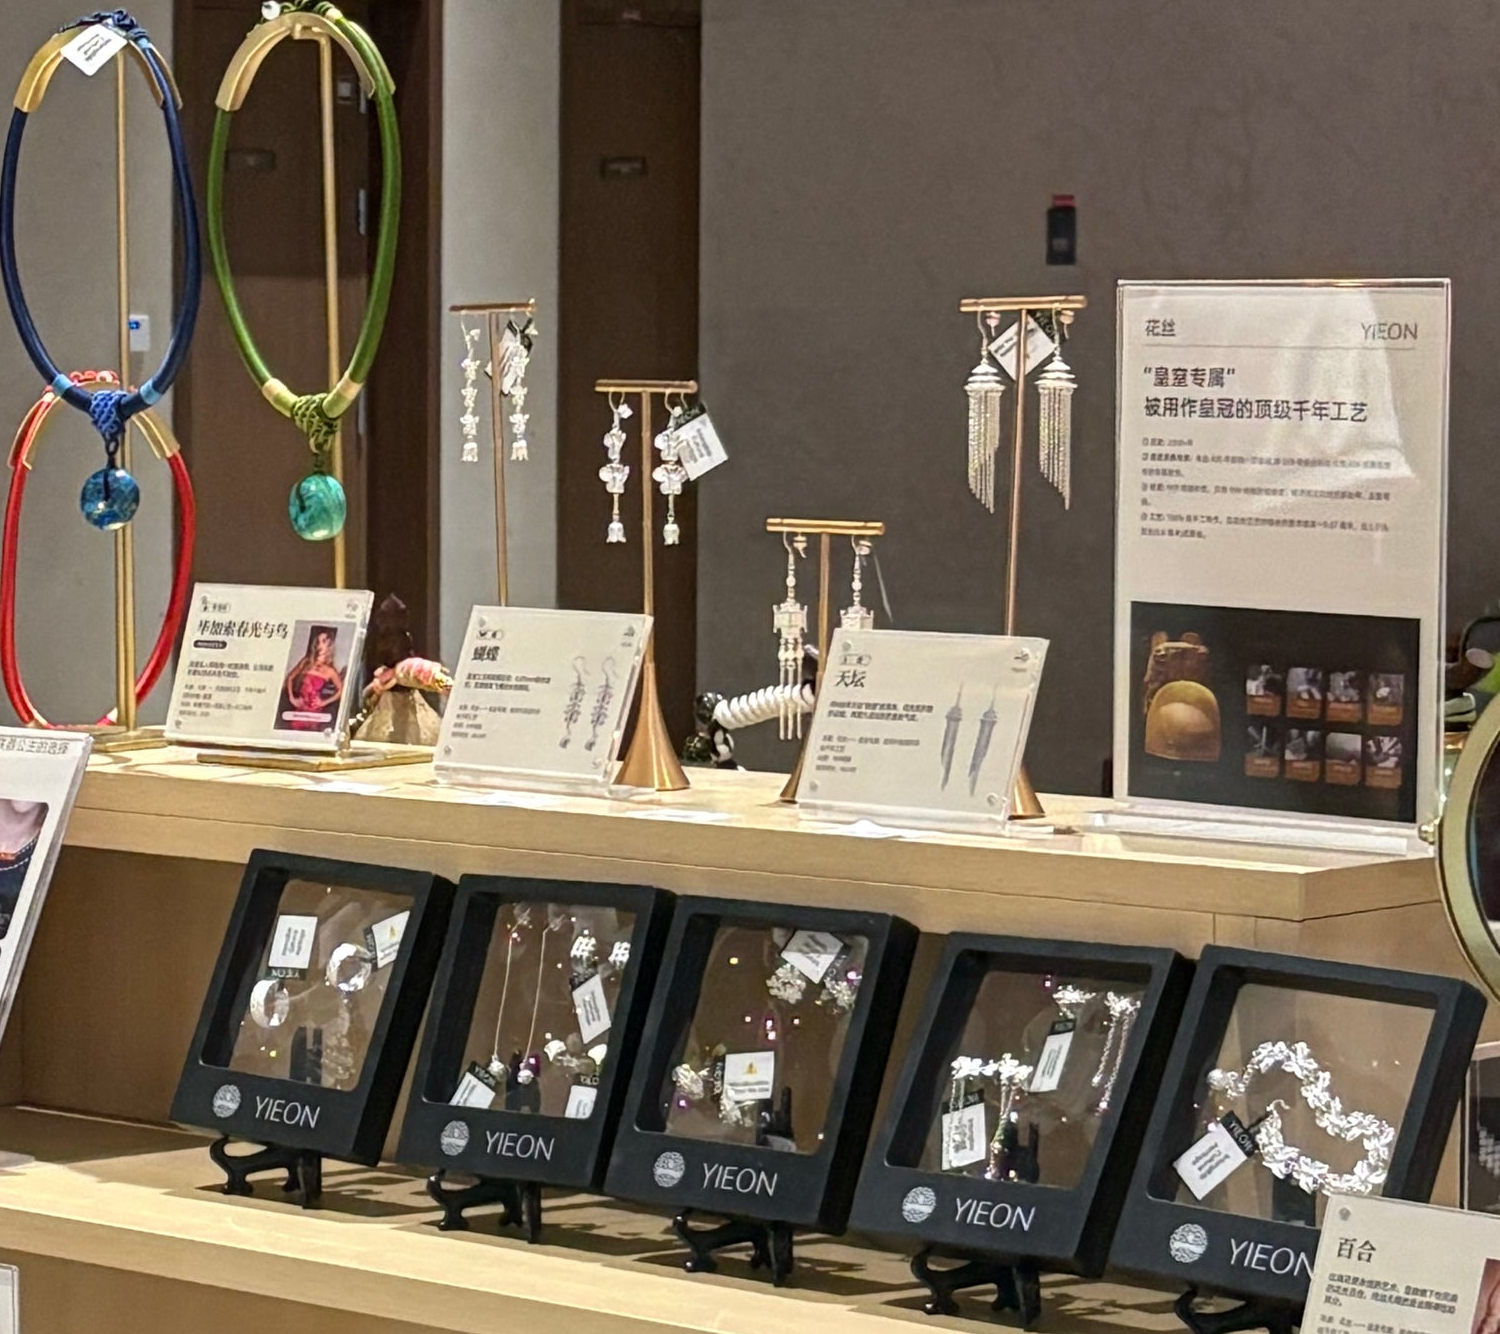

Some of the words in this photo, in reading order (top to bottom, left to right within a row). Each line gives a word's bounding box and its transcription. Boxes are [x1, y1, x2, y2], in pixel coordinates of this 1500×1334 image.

[1145, 318, 1177, 338] 花丝
[1361, 322, 1418, 341] YIEON
[1144, 396, 1368, 423] 被用作皇冠的顶级千年工艺
[834, 669, 866, 688] 天坛
[256, 1097, 321, 1129] YIEON
[485, 1130, 556, 1162] YIEON
[702, 1162, 778, 1198] YIEON
[955, 1197, 1036, 1233] YIEON
[1336, 1237, 1377, 1264] 百合
